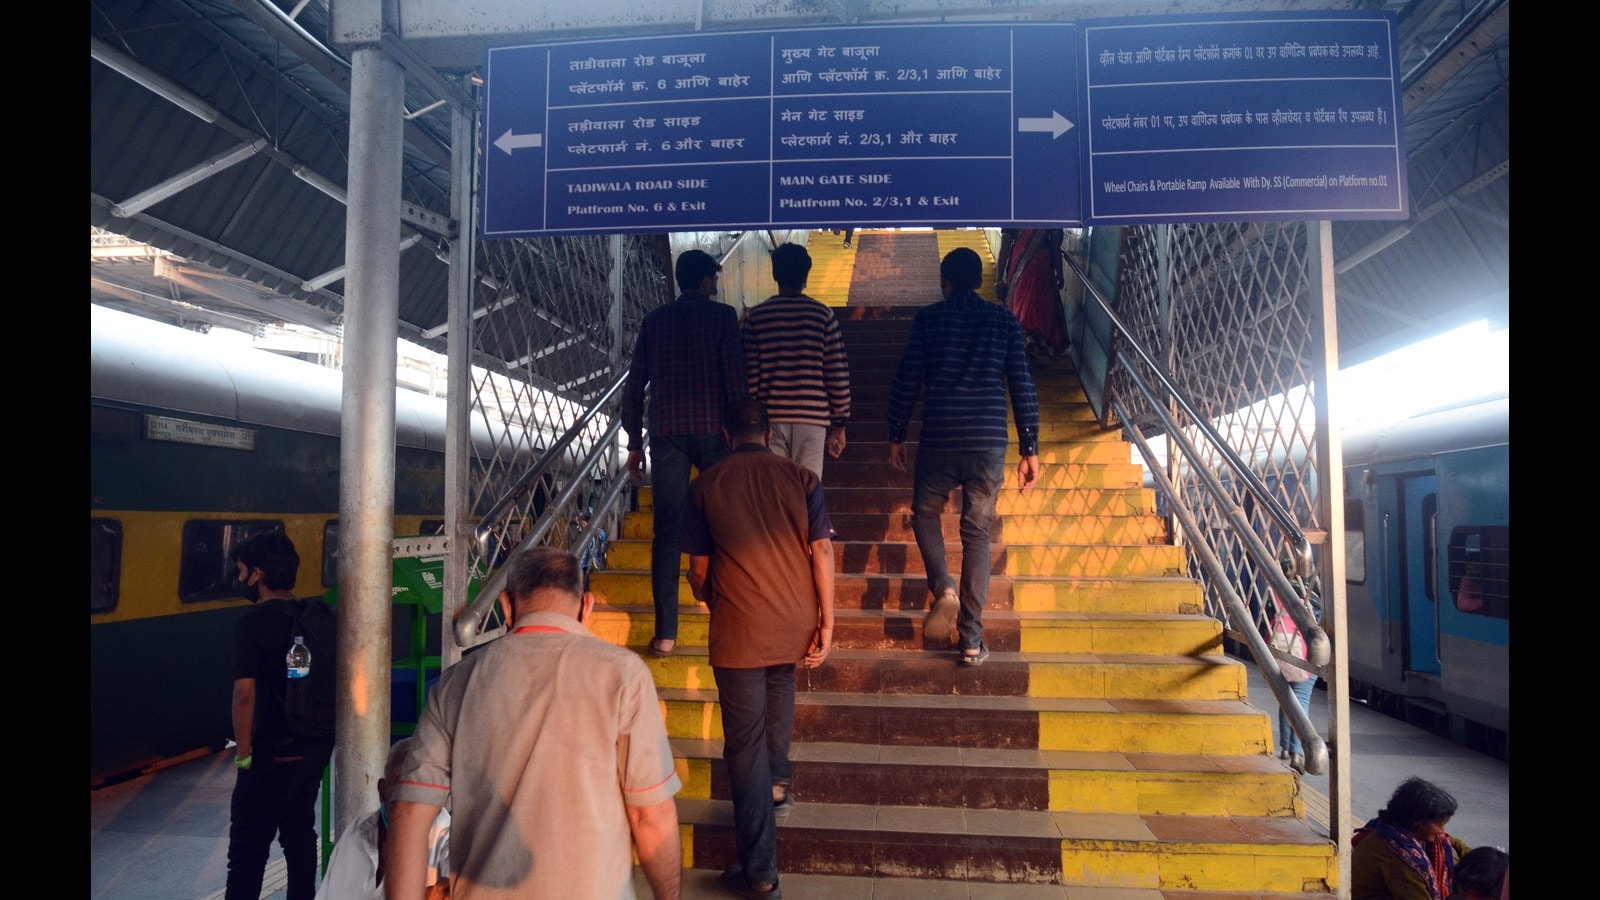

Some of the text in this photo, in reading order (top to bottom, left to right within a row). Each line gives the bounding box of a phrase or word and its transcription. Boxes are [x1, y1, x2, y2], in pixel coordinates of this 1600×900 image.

[570, 53, 706, 70] ताडीवाला रोड बाजूला
[782, 45, 880, 64] मुख्य गेट बाजूला
[1100, 49, 1115, 67] व्हील
[1118, 49, 1133, 64] चेअर
[1136, 47, 1152, 63] आणि
[1154, 46, 1175, 62] पोर्टेबल
[1194, 44, 1220, 60] प्लॅटफॉर्म
[1222, 44, 1242, 59] क्रमांक
[1245, 47, 1253, 59] 01
[1256, 47, 1264, 59] वर
[1267, 47, 1277, 58] उप
[1342, 45, 1364, 57] उपलब्ध
[782, 66, 1002, 83] आणि प्लॅटफॉर्म क्र. 2/3,1 आणि बाहेर
[569, 74, 750, 94] प्लॅटफॉर्म क्र. 6 आणि बाहेर
[781, 108, 865, 122] मेन गेट साइड
[1102, 114, 1130, 129] प्लेटफार्म
[1133, 114, 1148, 128] नंबर
[1151, 115, 1159, 128] 01
[1164, 116, 1175, 128] पर,
[1178, 116, 1188, 127] उप
[1191, 111, 1218, 125] वाणिज्य
[1221, 111, 1242, 125] प्रबंधक
[1245, 110, 1252, 124] के
[1255, 113, 1269, 124] पास
[1271, 109, 1302, 125] व्हीलचेयर
[1305, 112, 1311, 122] व
[1313, 108, 1335, 123] पोर्टेबल
[1350, 111, 1374, 122] उपलब्ध
[568, 117, 701, 133] तड़ीवाला रोड साइड
[568, 137, 745, 154] प्लेटफार्म नं. 6 और बाहर
[781, 130, 957, 146] प्लेटफार्म नं. 2/3,1 और बाहर
[567, 179, 707, 193] TADIWALA ROAD SIDE
[780, 175, 891, 185] MAIN GATE SIDE
[1104, 175, 1387, 192] Wheel Chairs & Portable Ramp Available With Dy. SS (Commercial) on Platform no.01
[568, 201, 705, 214] Platfrom No. 6 & Exit
[780, 196, 959, 207] Platfrom No. 2/3,1 & Exit
